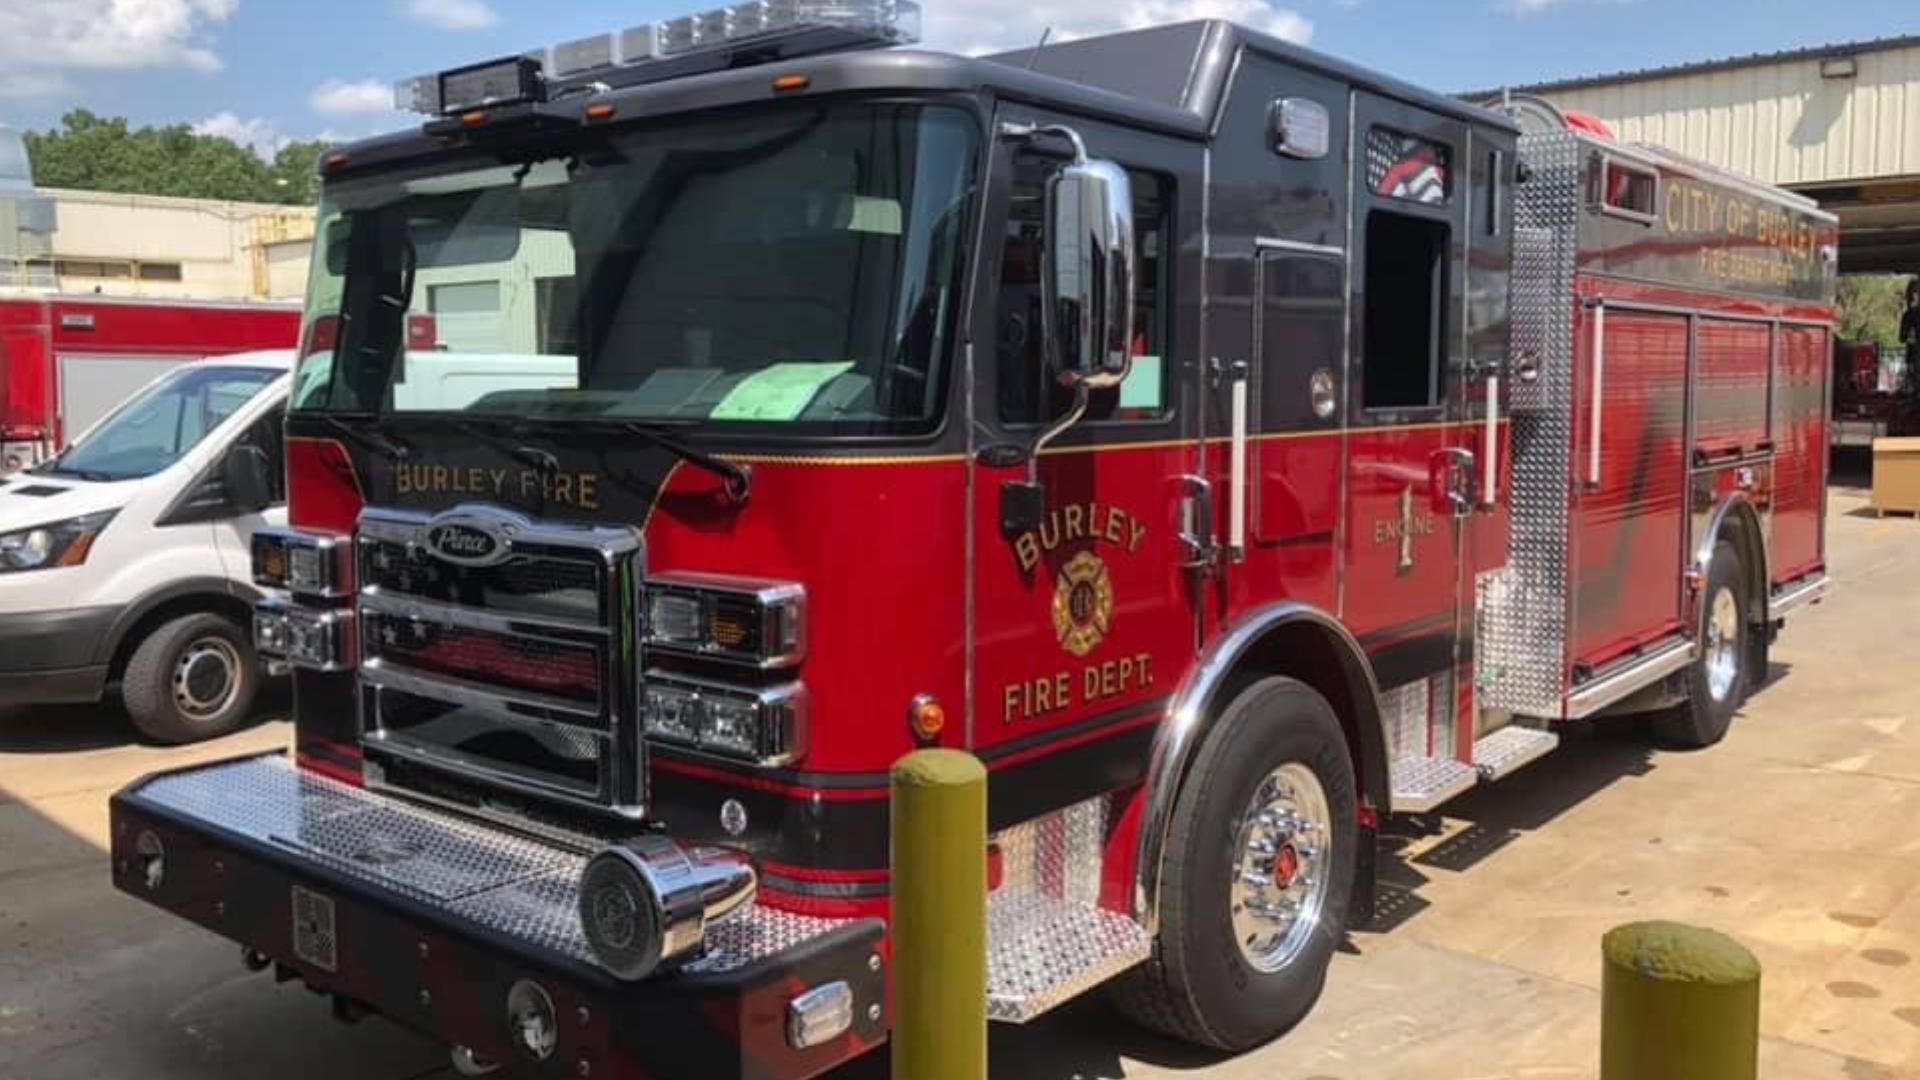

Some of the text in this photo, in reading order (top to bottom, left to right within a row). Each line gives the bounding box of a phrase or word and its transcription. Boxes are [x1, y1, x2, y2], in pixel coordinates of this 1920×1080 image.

[1665, 183, 1817, 264] CITY OF BURLEY
[397, 464, 598, 508] BURLEY FIRE
[1014, 502, 1146, 573] BURLEY
[1003, 653, 1154, 722] FIRE DEPT.
